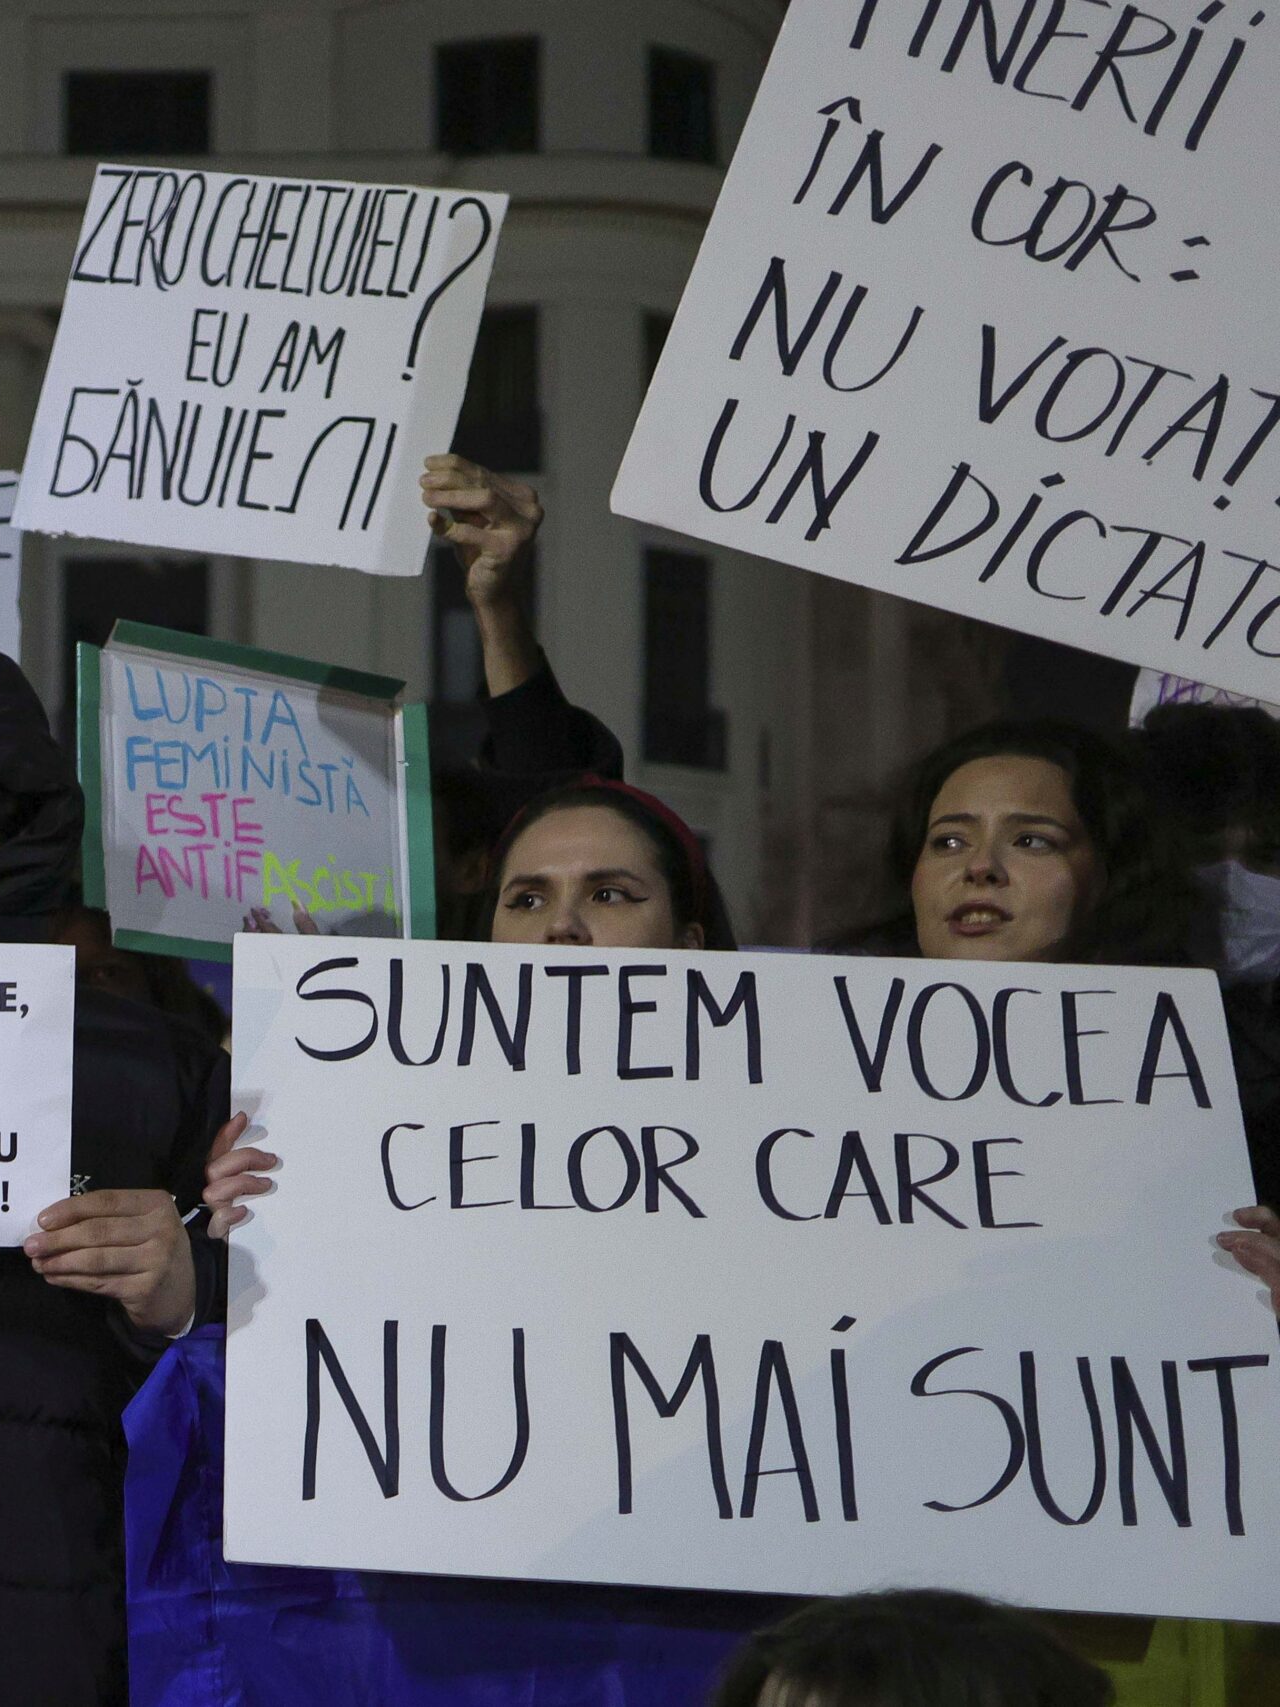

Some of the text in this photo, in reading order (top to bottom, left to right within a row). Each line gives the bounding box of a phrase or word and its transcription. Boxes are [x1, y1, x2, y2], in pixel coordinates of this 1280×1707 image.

[792, 96, 944, 225] ÎN
[70, 169, 207, 292] ZERO
[186, 308, 346, 399] EU AM
[727, 255, 925, 393] NU
[697, 398, 880, 542] UN
[124, 662, 309, 759] LUPTA
[145, 793, 265, 845] ESTE
[293, 956, 1213, 1109] SUNTEM VOCEA
[380, 1120, 1044, 1230] CELOR CARE
[301, 1317, 531, 1503] NU
[909, 1345, 1270, 1536] SUNT
